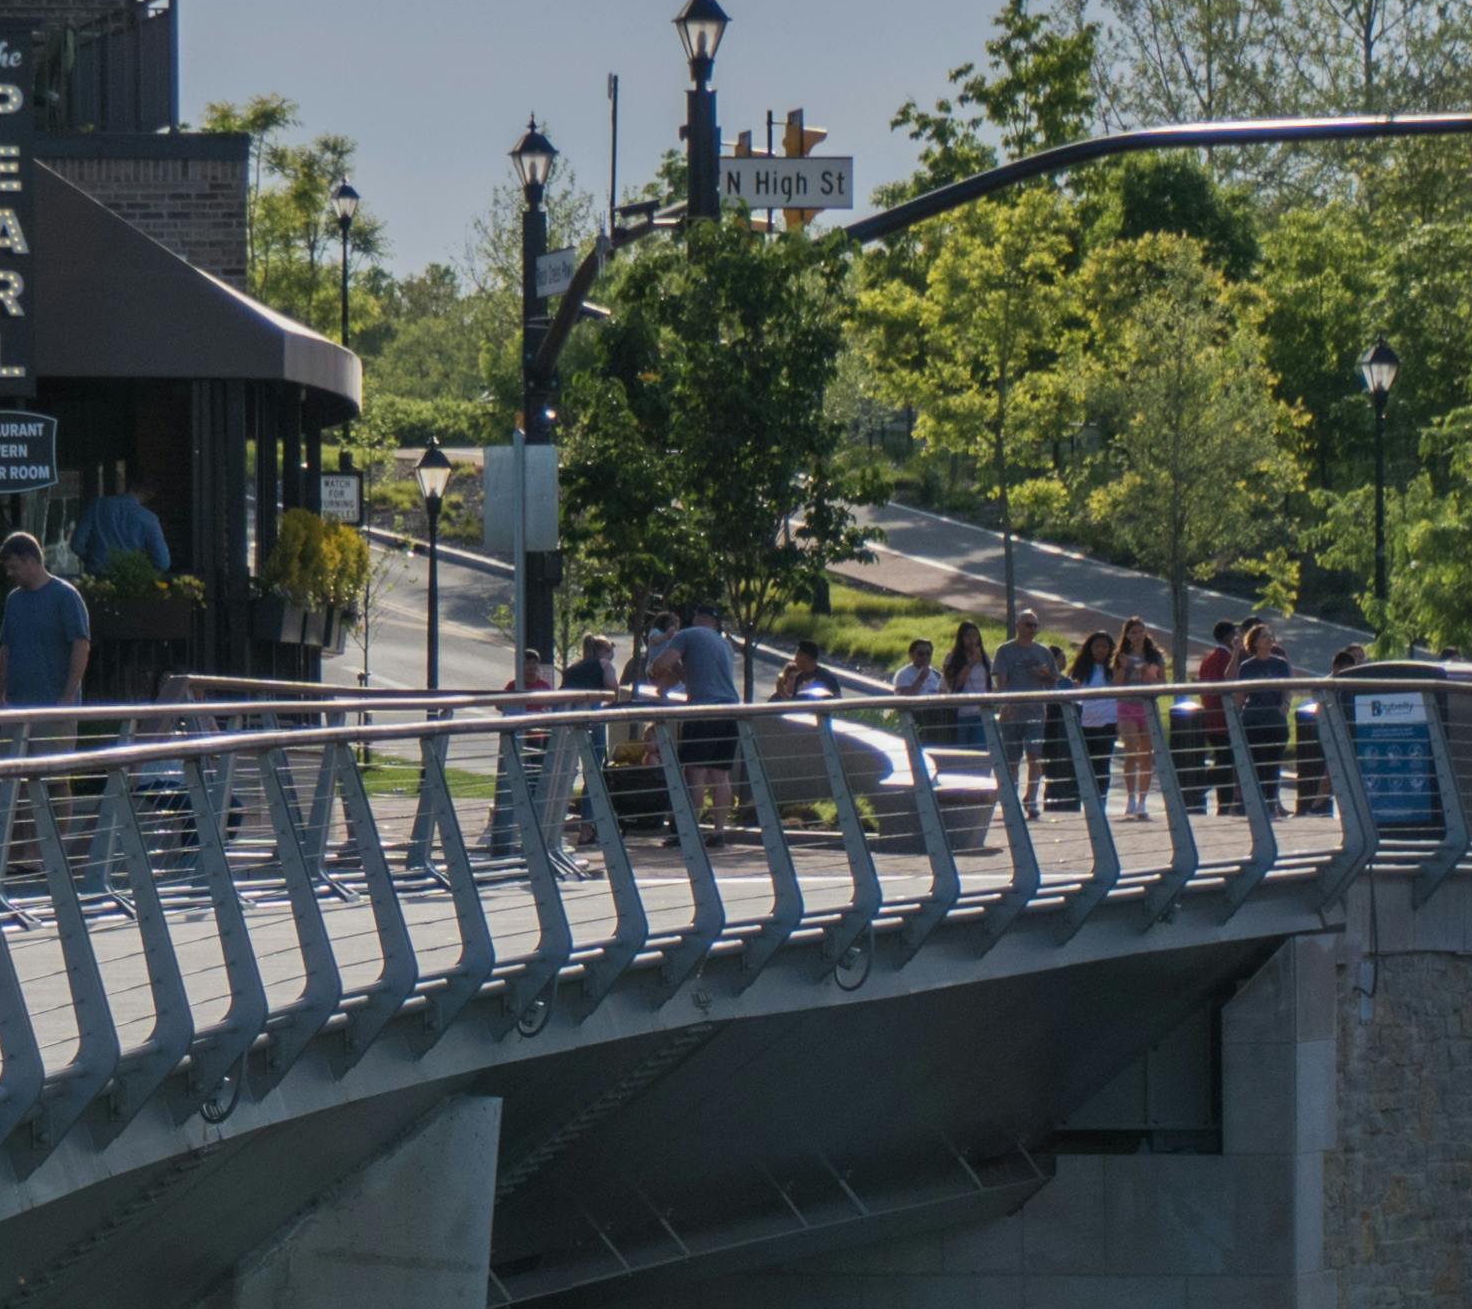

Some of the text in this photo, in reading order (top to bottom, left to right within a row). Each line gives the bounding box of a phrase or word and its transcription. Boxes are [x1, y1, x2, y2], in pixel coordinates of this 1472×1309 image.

[727, 170, 845, 203] N High St
[10, 466, 50, 479] ROOM
[324, 479, 351, 488] WATCH
[328, 489, 345, 499] FOR
